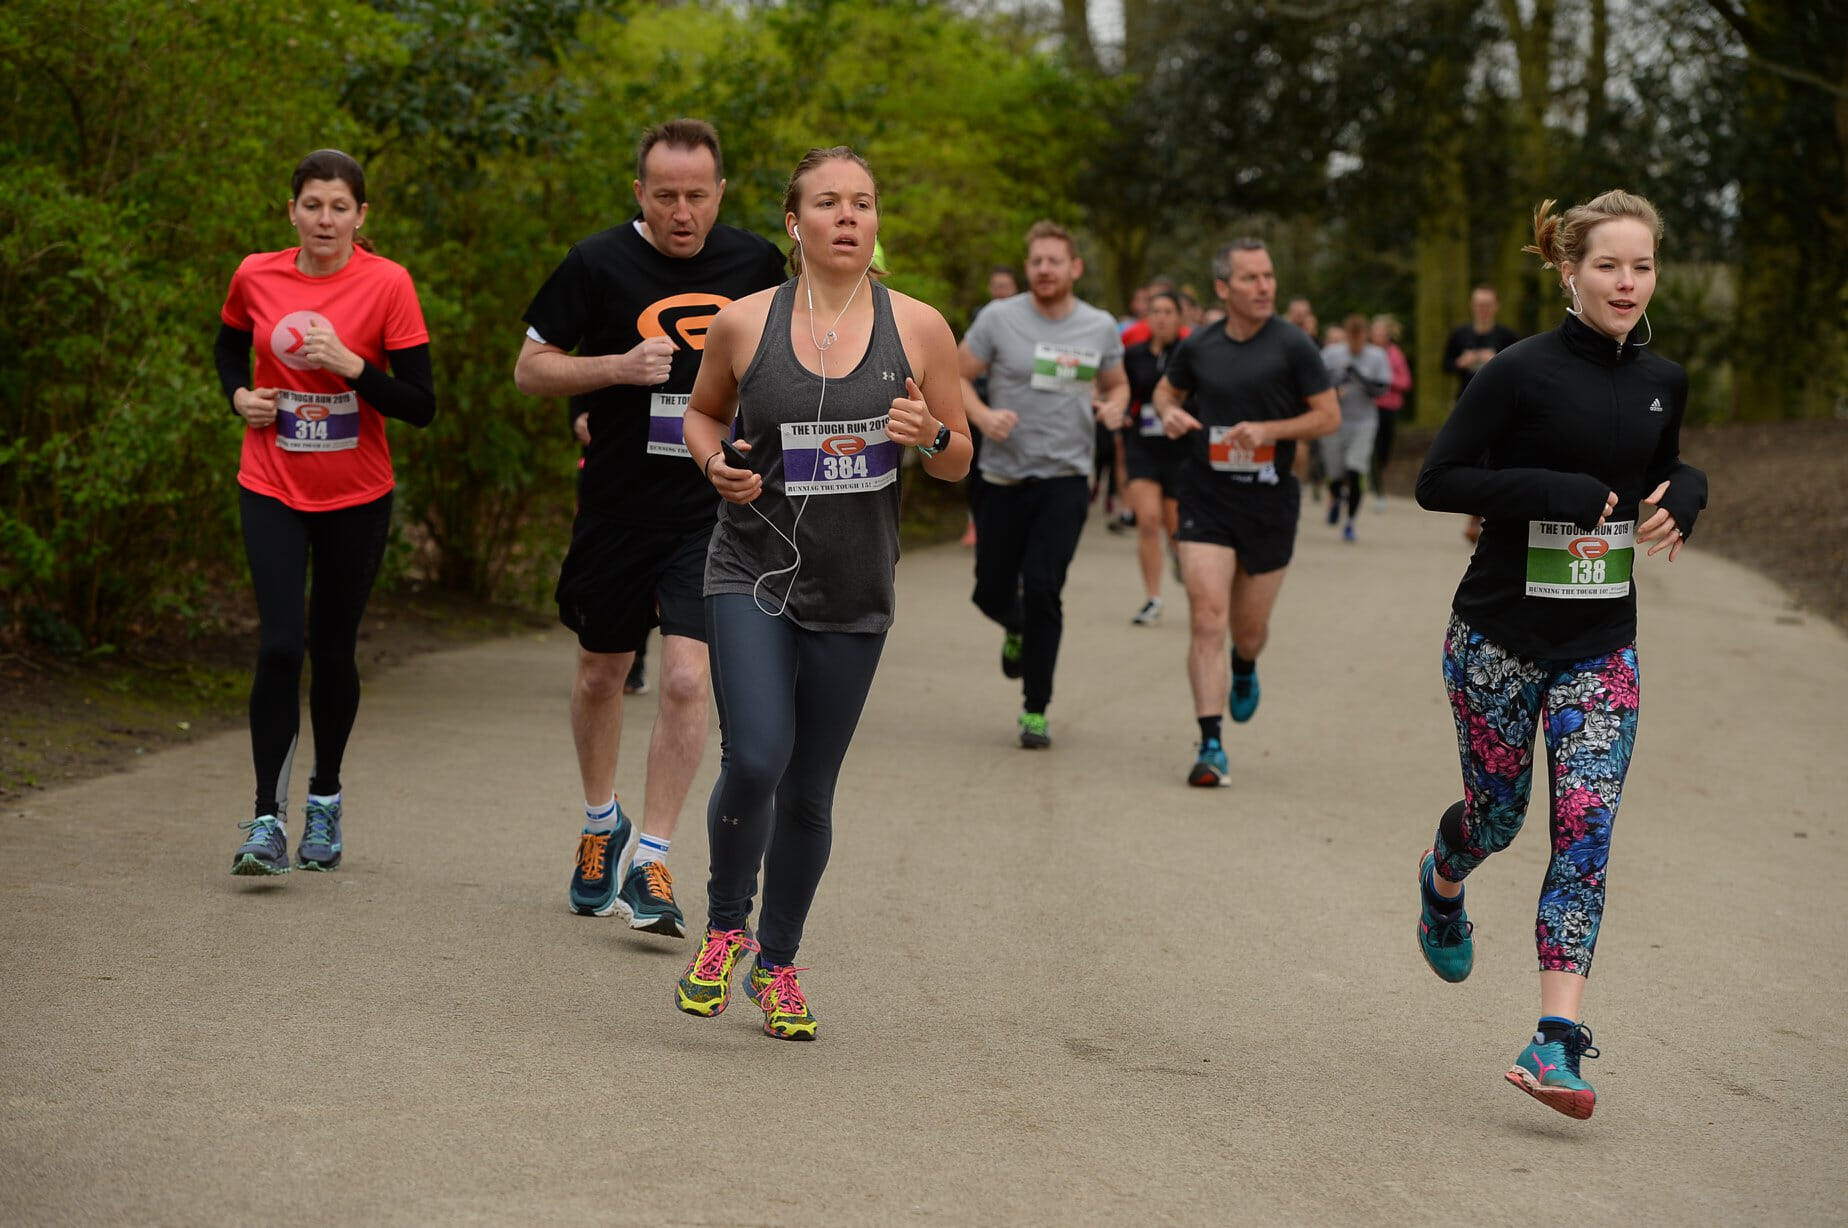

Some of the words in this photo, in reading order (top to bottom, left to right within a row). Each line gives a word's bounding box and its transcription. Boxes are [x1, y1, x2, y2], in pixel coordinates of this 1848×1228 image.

[291, 392, 314, 403] TOUGH
[315, 395, 331, 403] RUN
[660, 395, 675, 405] THE
[295, 420, 328, 440] 314
[791, 425, 810, 435] THE
[811, 424, 844, 435] TOUGH
[847, 422, 867, 434] RUN
[823, 454, 868, 480] 384
[787, 484, 819, 492] RUNNING
[821, 483, 835, 491] THE
[836, 482, 859, 491] TOUGH
[1541, 523, 1558, 535] THE
[1594, 525, 1612, 536] RUN
[1613, 523, 1629, 536] 2019
[1568, 559, 1606, 584] 138
[1528, 586, 1560, 594] RUNNING
